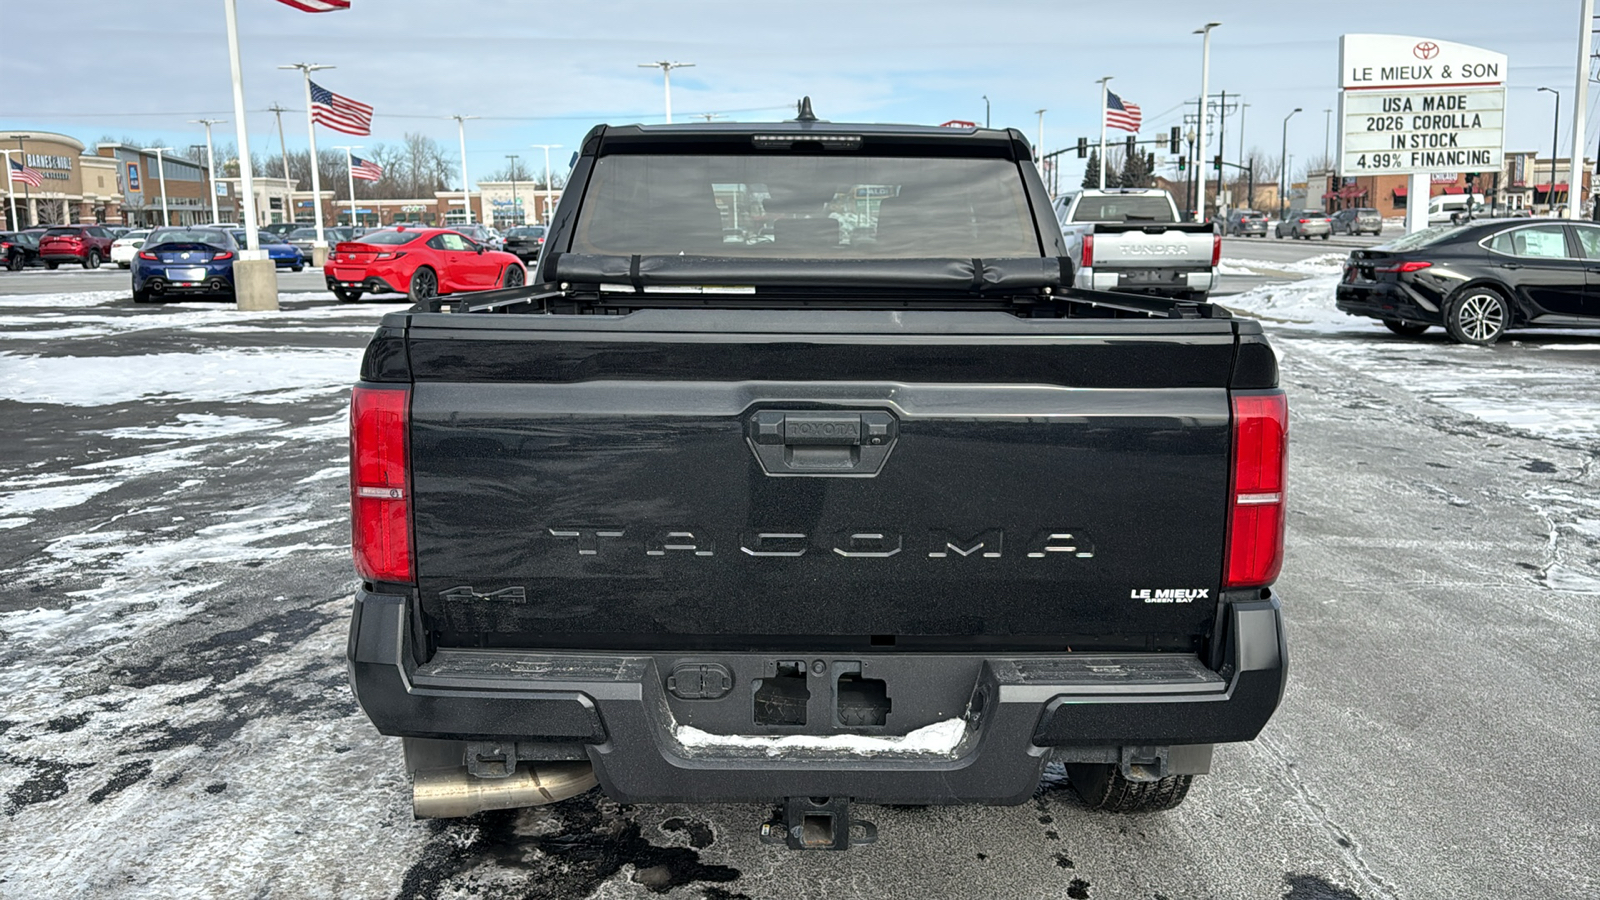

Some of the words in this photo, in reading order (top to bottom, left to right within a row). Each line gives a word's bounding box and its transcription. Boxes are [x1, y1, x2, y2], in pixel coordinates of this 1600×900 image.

[1353, 67, 1373, 81] LE
[1381, 65, 1433, 80] MIEUX
[1441, 65, 1452, 78] &
[1461, 63, 1498, 78] SON
[1383, 97, 1412, 112] USA
[1423, 95, 1467, 111] MADE
[1366, 116, 1404, 131] 2026
[1413, 113, 1482, 130] COROLLA
[1391, 134, 1406, 149] IN
[1410, 132, 1458, 148] STOCK
[1357, 153, 1402, 169] 4.99%
[1411, 150, 1490, 166] FINANCING
[1119, 245, 1188, 255] TUNDRA
[788, 422, 858, 436] TOYOTA
[547, 526, 1095, 558] TACOMA
[1131, 589, 1151, 598] LE
[1155, 589, 1209, 598] MIEUX
